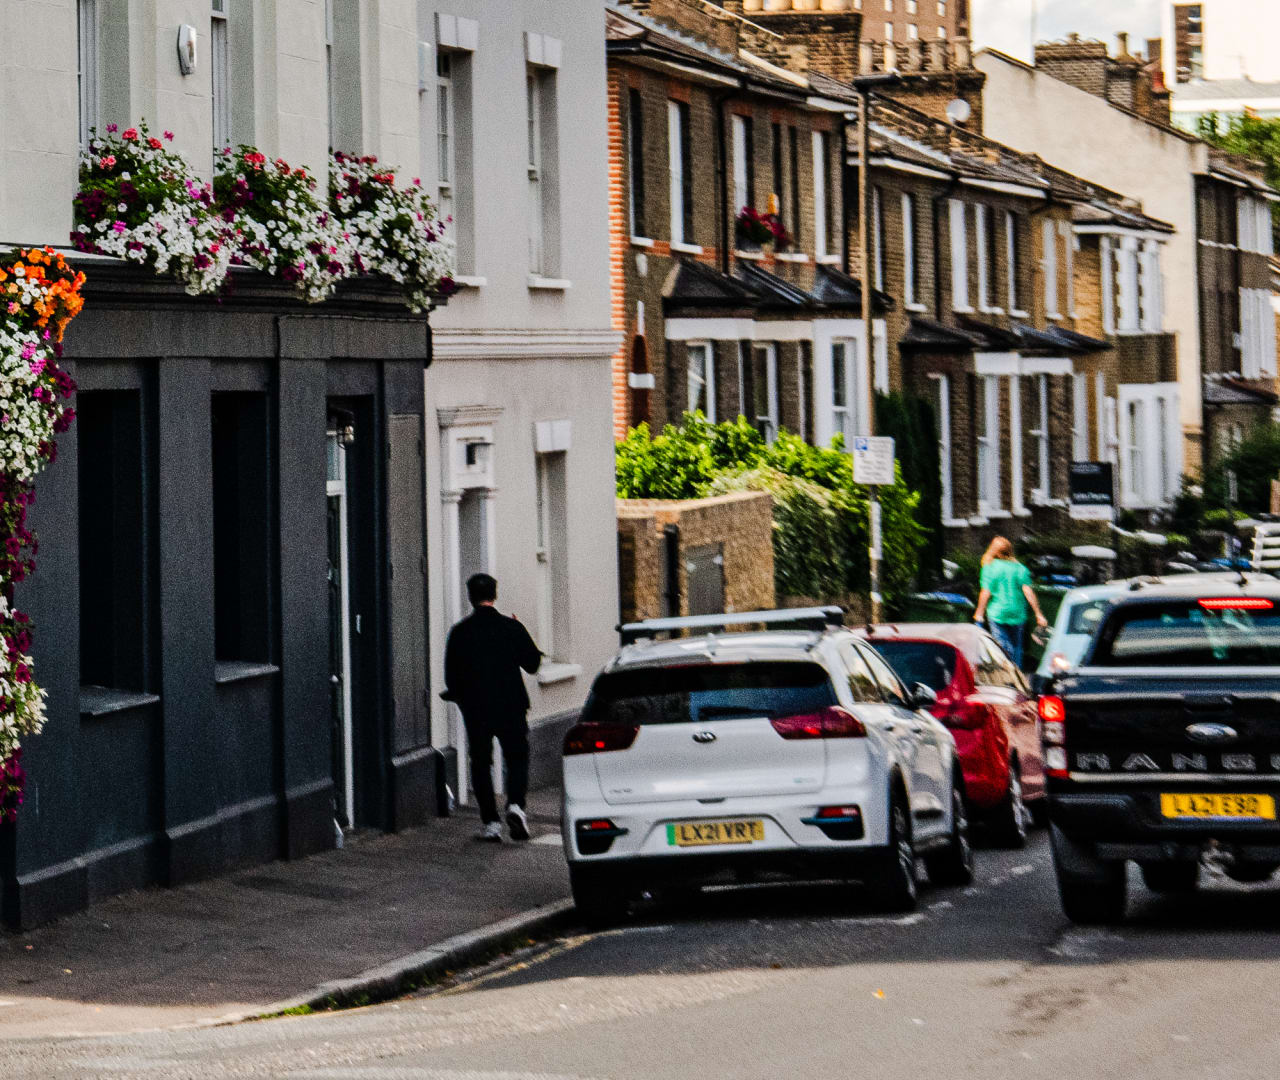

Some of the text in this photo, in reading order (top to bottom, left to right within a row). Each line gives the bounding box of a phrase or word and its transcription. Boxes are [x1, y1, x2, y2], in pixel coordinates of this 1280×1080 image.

[1076, 752, 1280, 770] RANG
[681, 821, 757, 841] LX21 VRT
